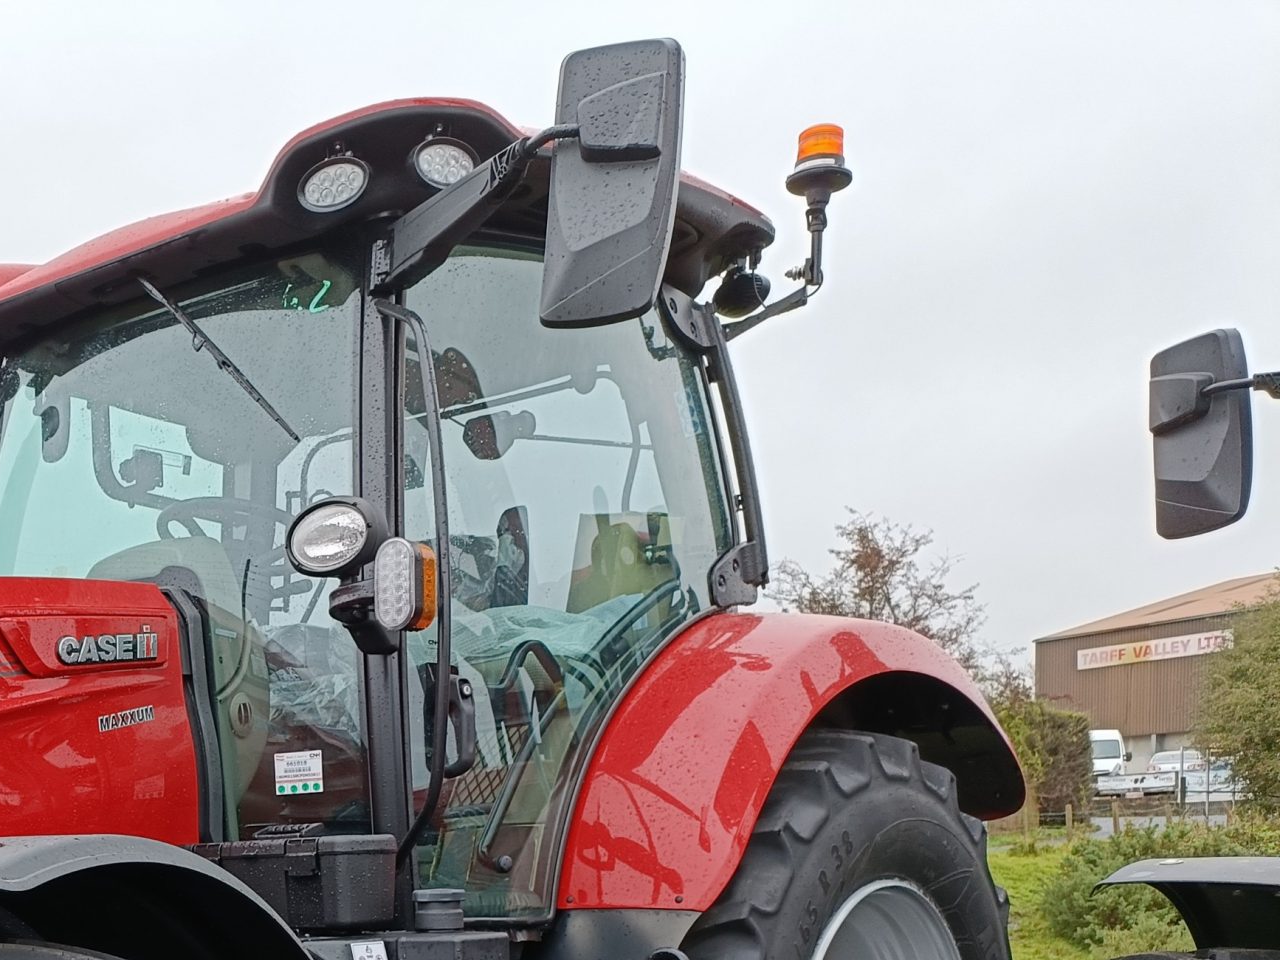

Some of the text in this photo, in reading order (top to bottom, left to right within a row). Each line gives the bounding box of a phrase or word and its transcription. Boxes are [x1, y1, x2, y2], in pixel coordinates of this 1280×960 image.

[57, 634, 134, 664] CASE
[1081, 648, 1126, 666] TARFF
[1133, 639, 1191, 658] VALLEY
[98, 705, 154, 732] MAXXUM
[830, 829, 854, 873] 38
